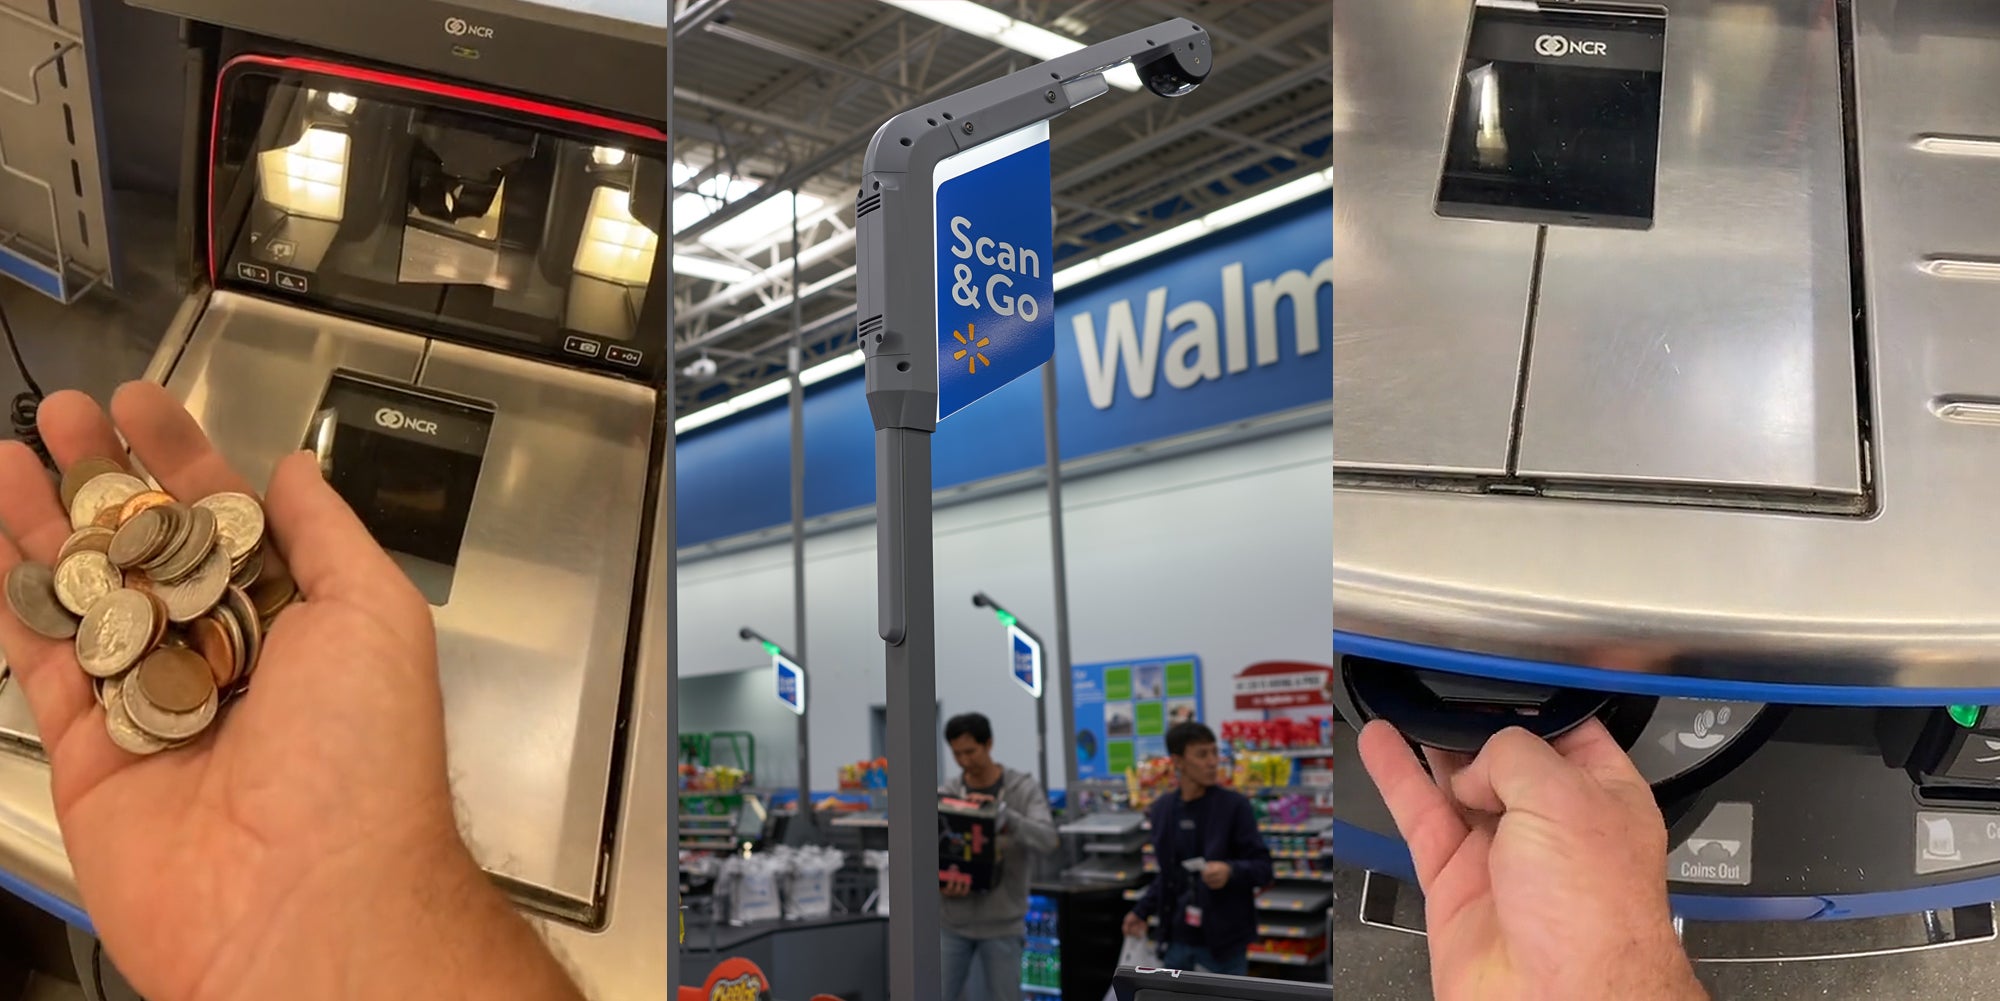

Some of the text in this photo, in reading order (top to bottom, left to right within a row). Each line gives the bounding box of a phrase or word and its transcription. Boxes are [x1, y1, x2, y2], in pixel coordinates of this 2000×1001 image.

[468, 25, 494, 39] NCR
[1569, 40, 1607, 55] NCR
[950, 216, 1040, 278] Scan
[951, 263, 1039, 322] & Go
[404, 416, 438, 436] NCR
[1680, 862, 1740, 879] Coins Out
